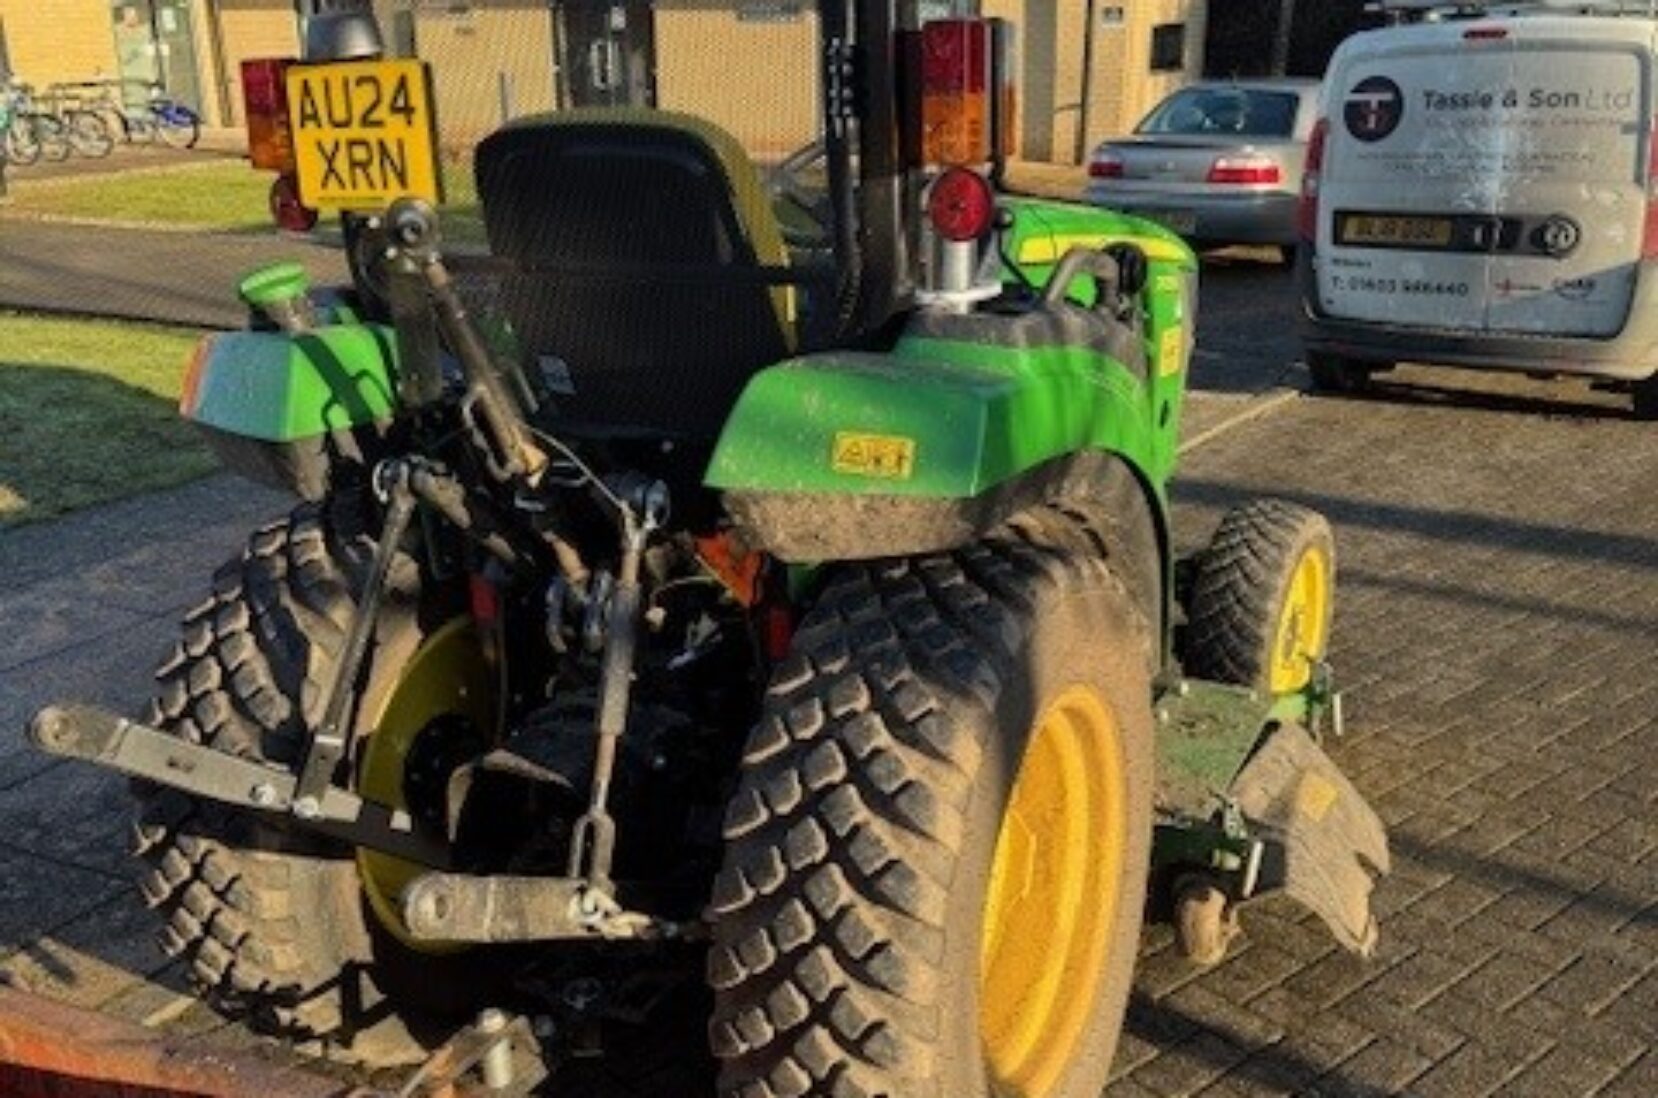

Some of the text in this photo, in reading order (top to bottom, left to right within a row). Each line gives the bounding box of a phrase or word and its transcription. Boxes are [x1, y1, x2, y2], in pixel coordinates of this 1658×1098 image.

[299, 73, 415, 129] AU24
[1423, 88, 1635, 111] Tassie & Son Ltd
[316, 137, 408, 190] XRN
